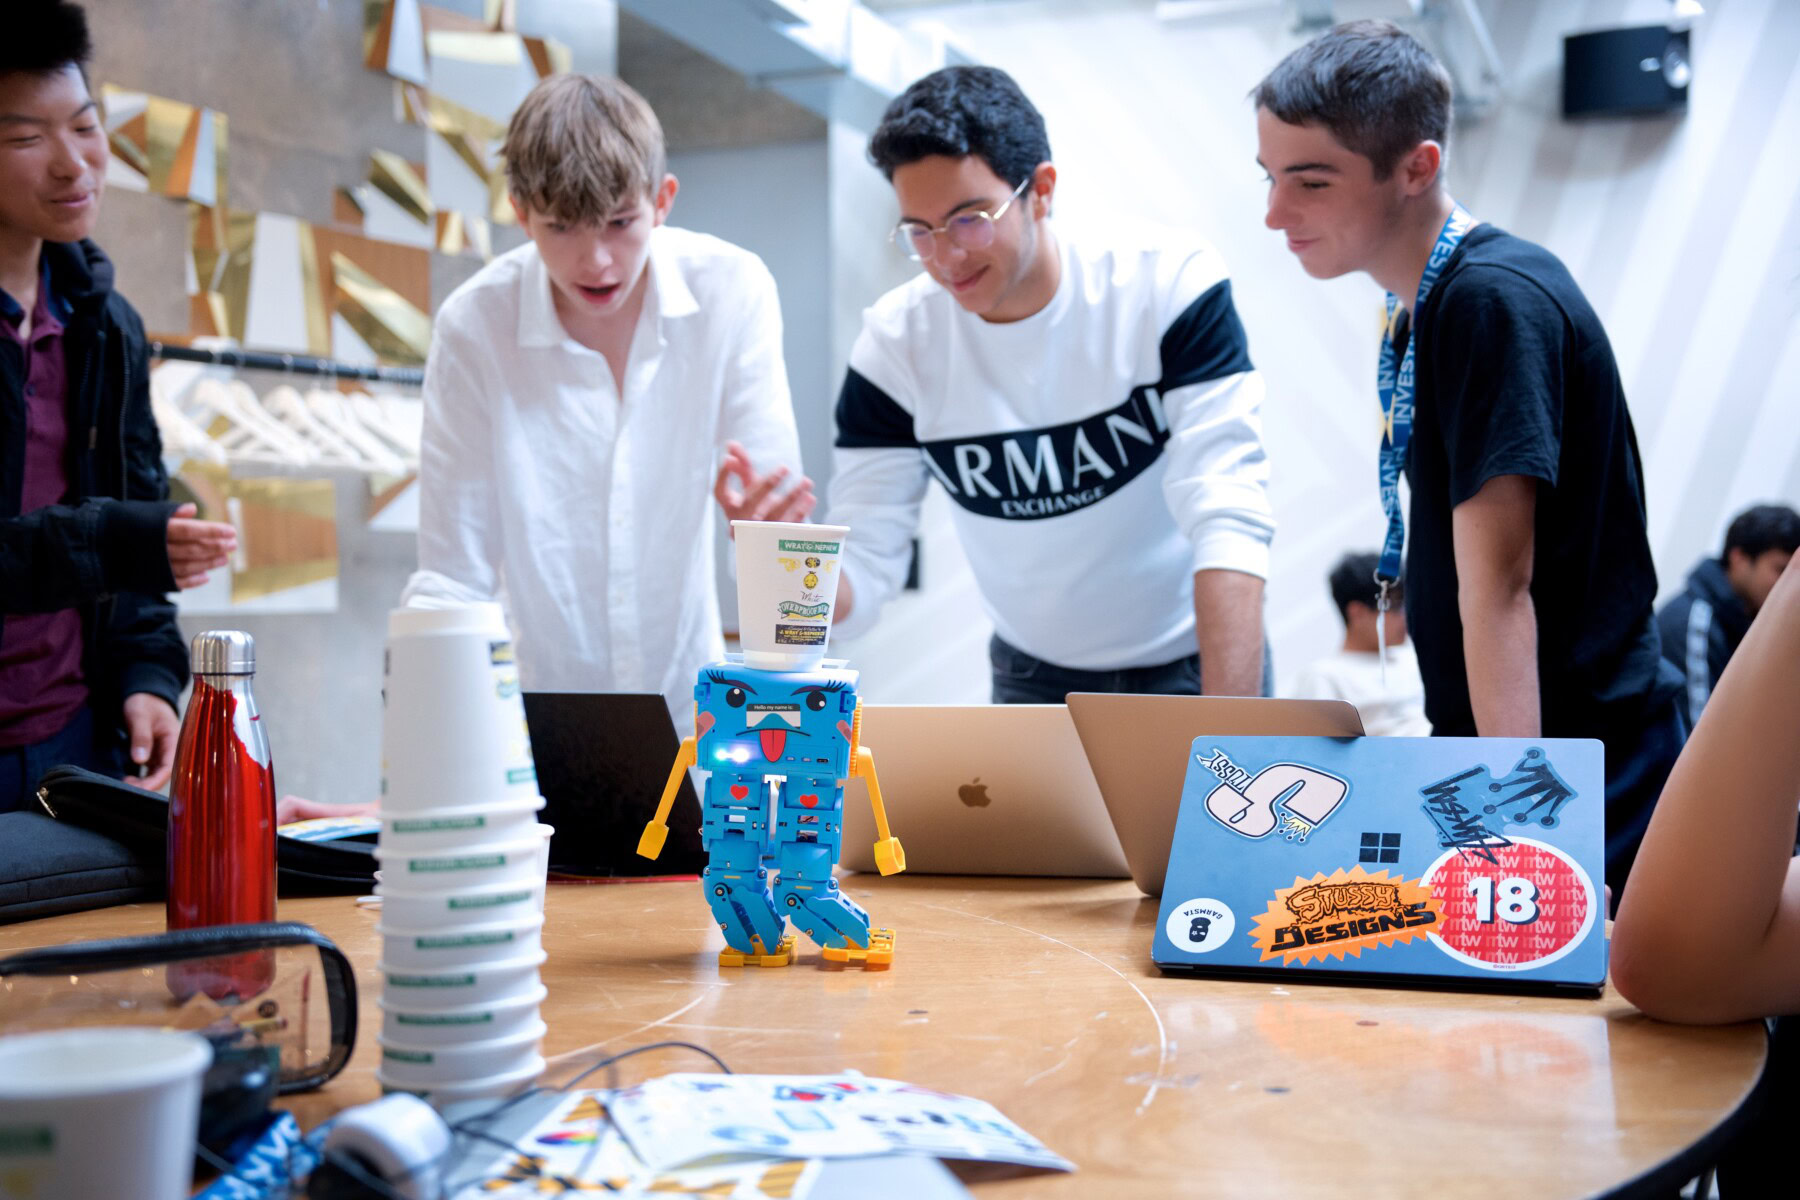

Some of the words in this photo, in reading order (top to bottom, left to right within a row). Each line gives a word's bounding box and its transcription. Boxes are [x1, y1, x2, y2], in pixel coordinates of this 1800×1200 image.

[1002, 485, 1106, 518] EXCHANGE
[1183, 908, 1223, 920] GARMSTA
[1288, 883, 1397, 922] STUSSY
[1468, 876, 1540, 924] 18
[1270, 901, 1436, 952] DESIGNS
